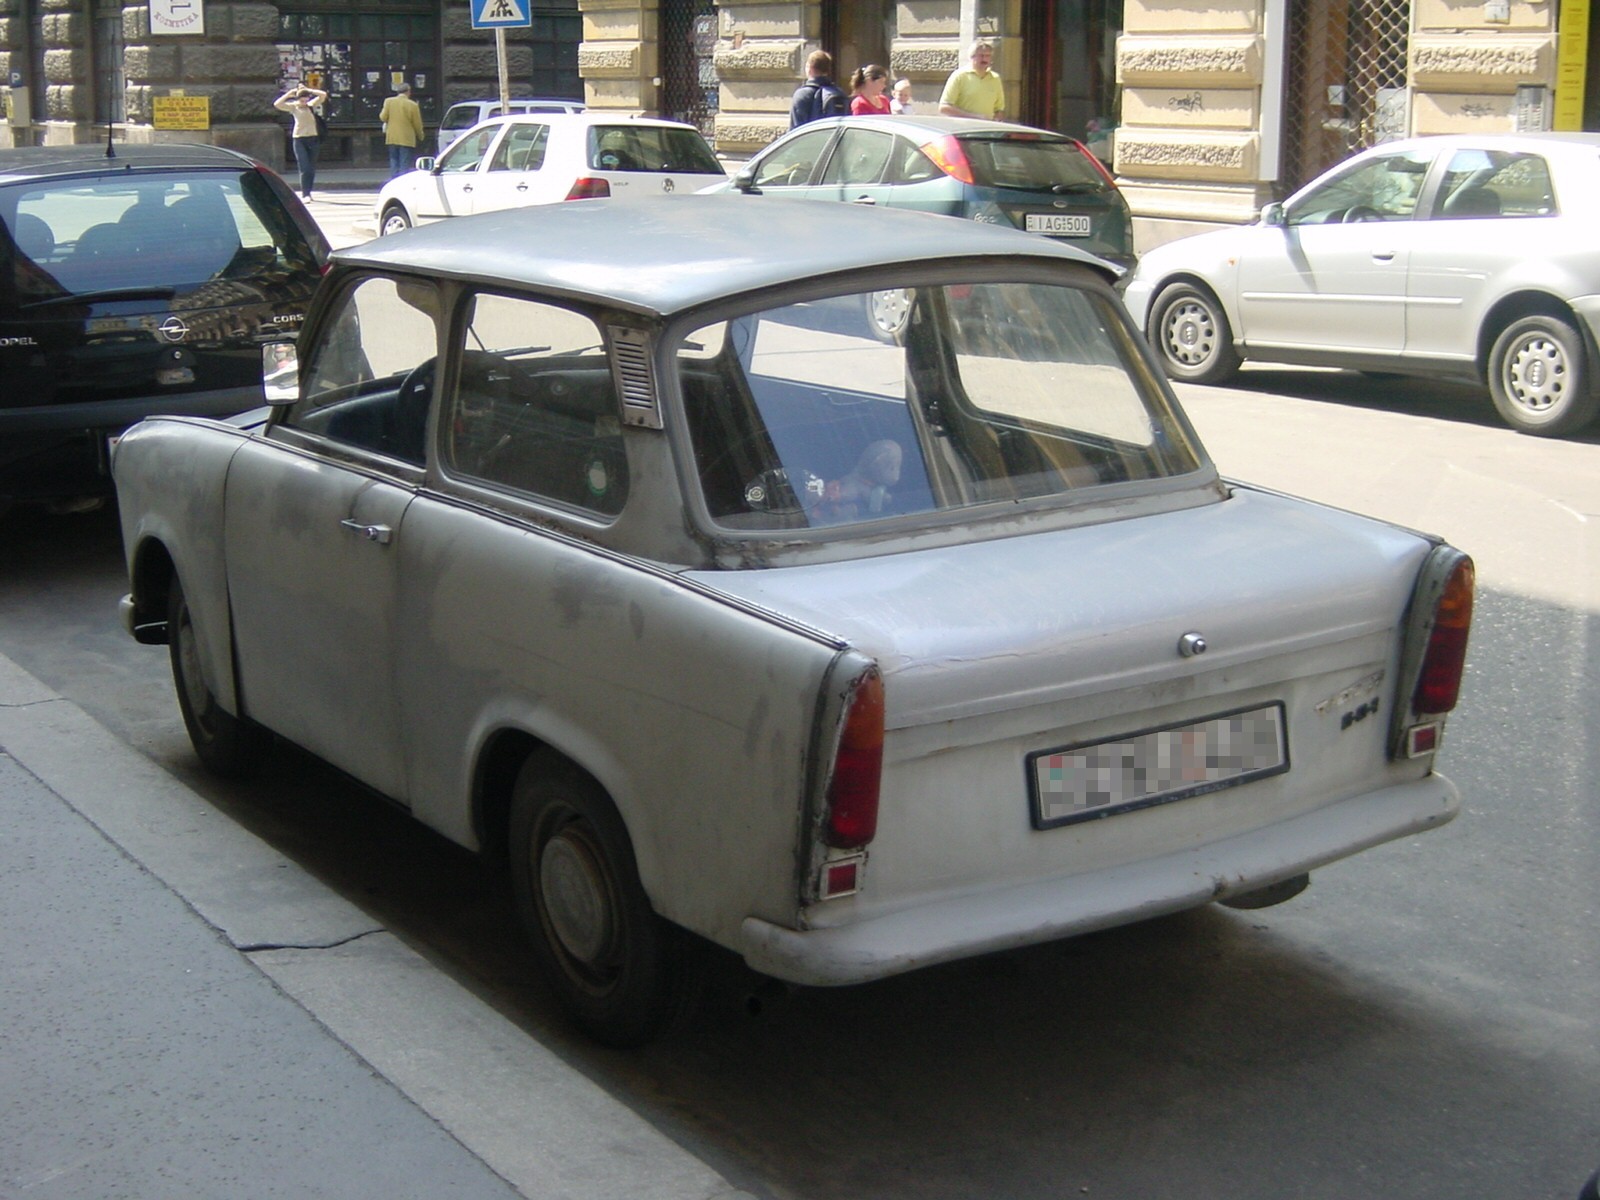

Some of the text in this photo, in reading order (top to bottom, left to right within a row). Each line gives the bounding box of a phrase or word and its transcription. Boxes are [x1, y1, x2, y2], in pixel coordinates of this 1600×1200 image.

[11, 72, 21, 84] P
[273, 313, 304, 324] CORS
[0, 336, 38, 347] OPEL
